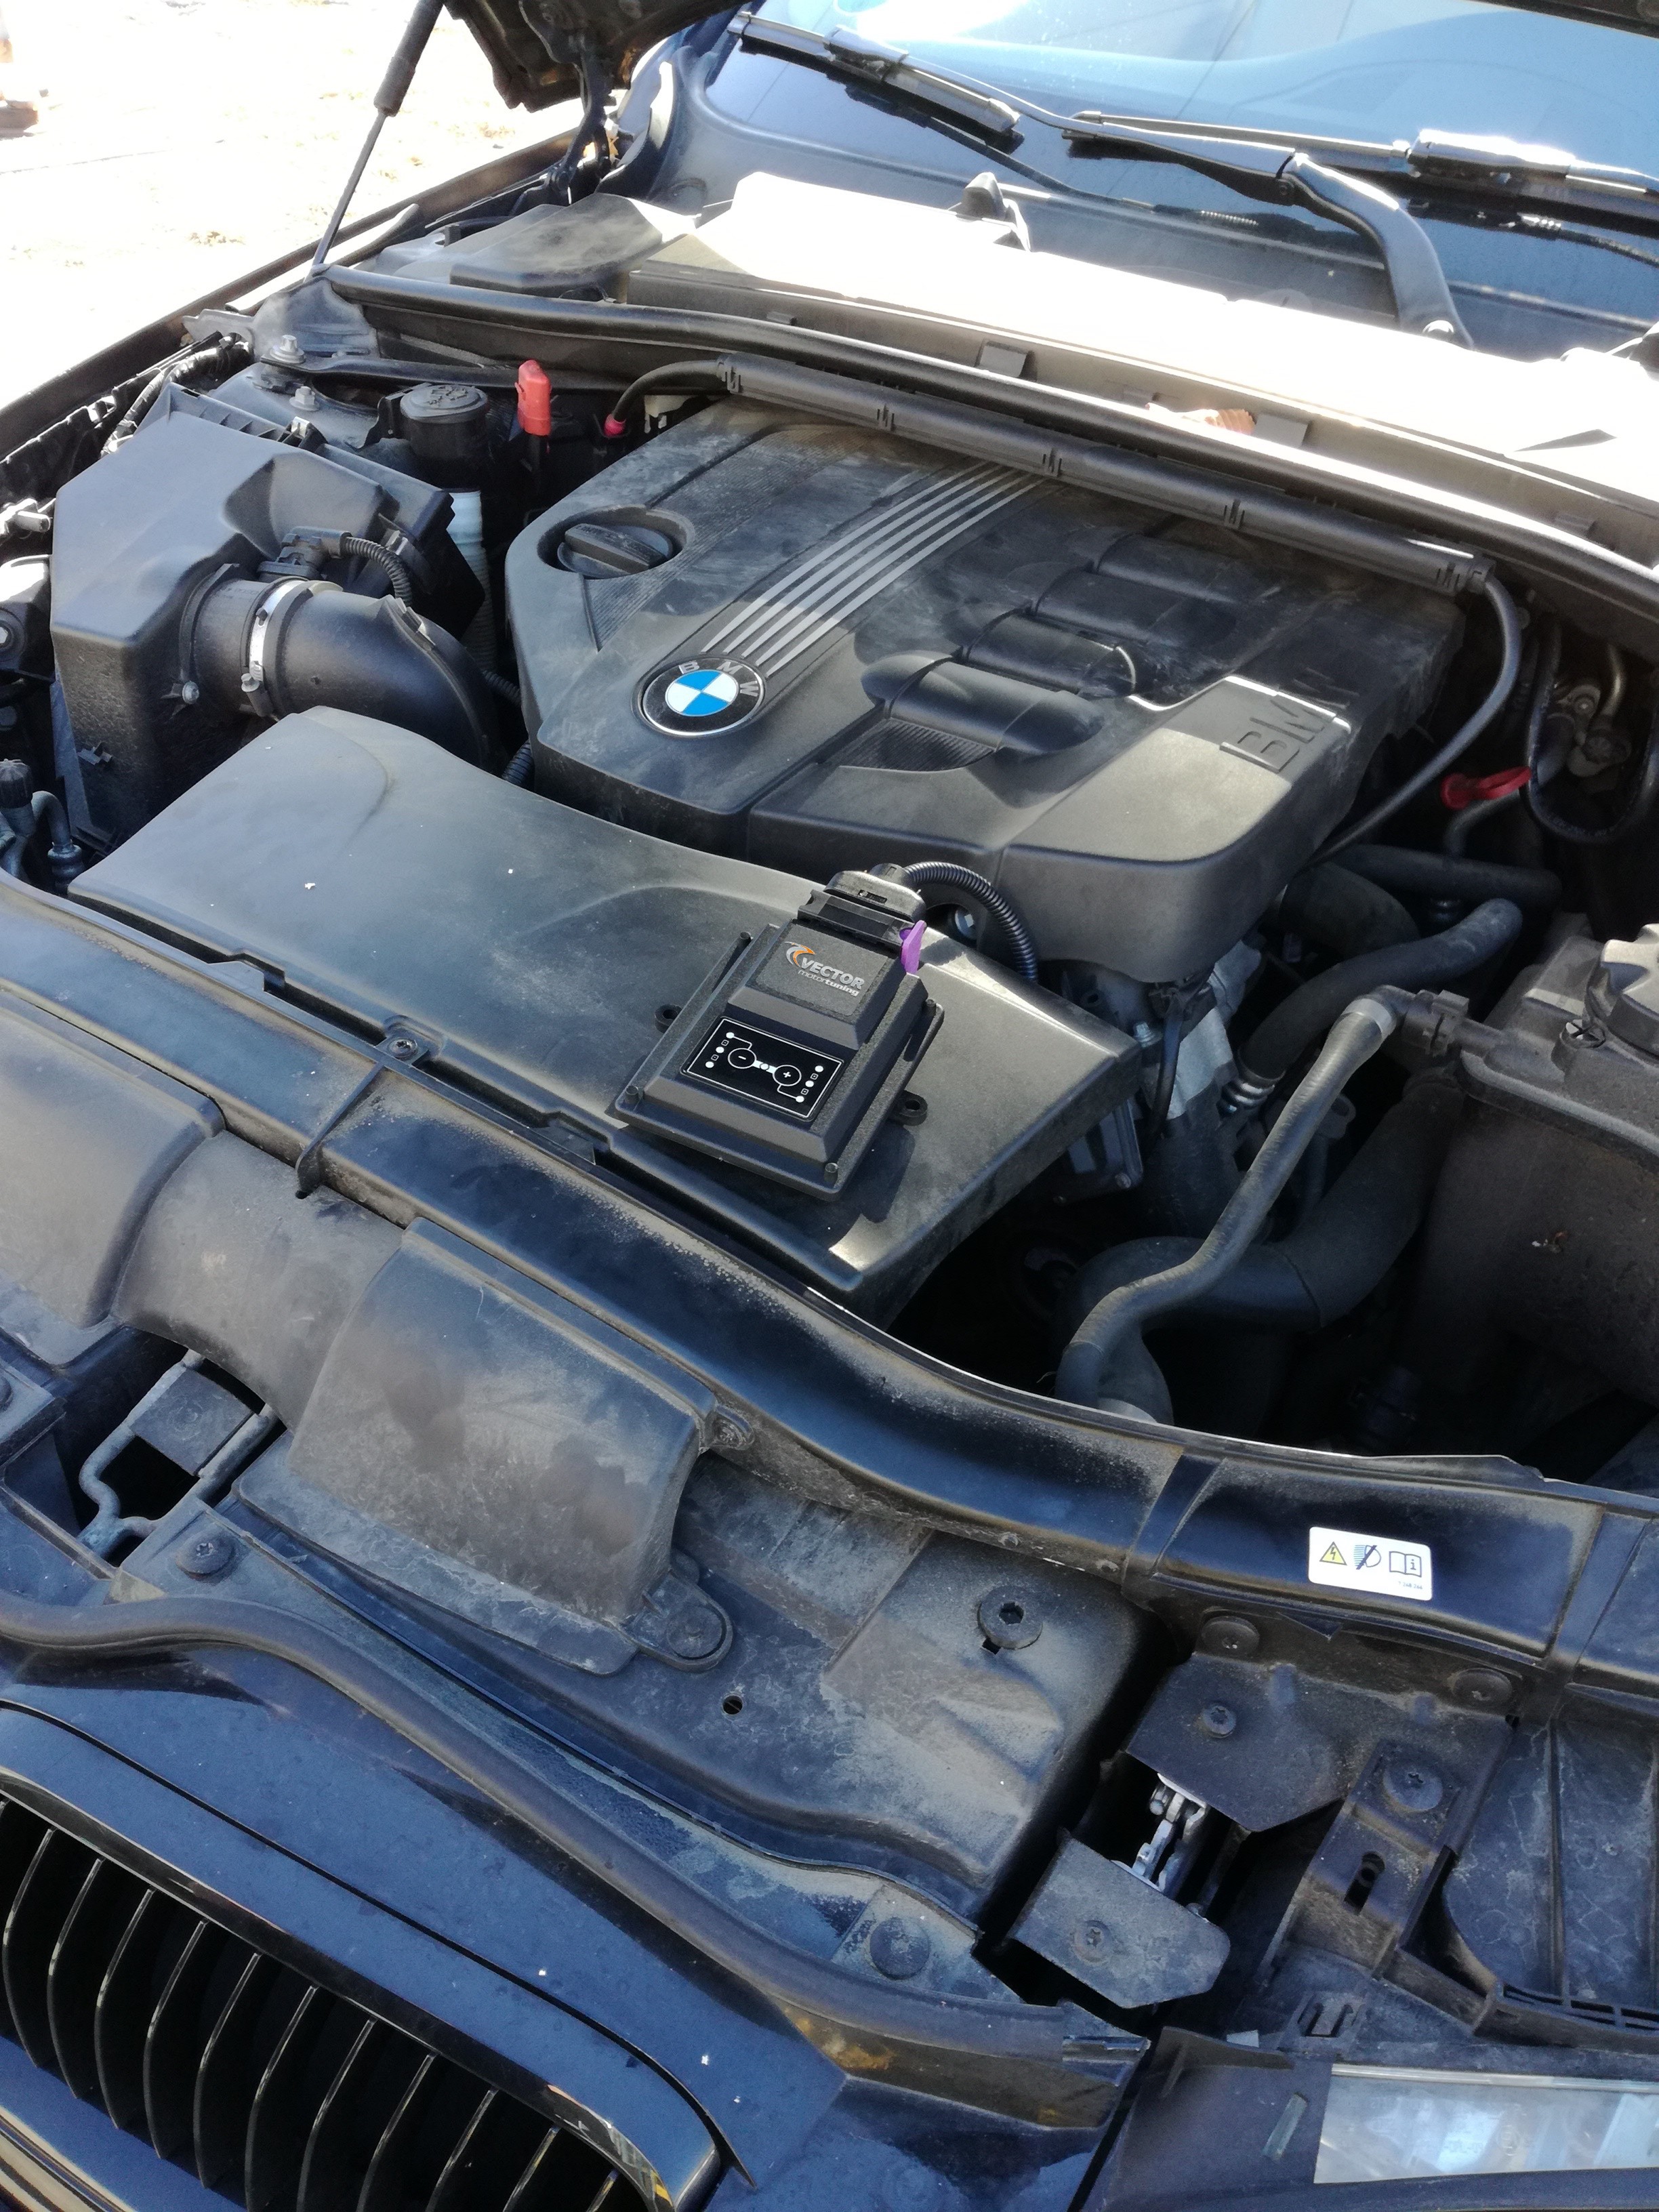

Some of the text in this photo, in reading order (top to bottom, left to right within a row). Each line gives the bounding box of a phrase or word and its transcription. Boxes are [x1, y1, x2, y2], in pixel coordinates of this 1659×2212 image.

[678, 660, 759, 697] BMW
[798, 970, 860, 997] motortuning
[801, 957, 865, 989] VECTOR
